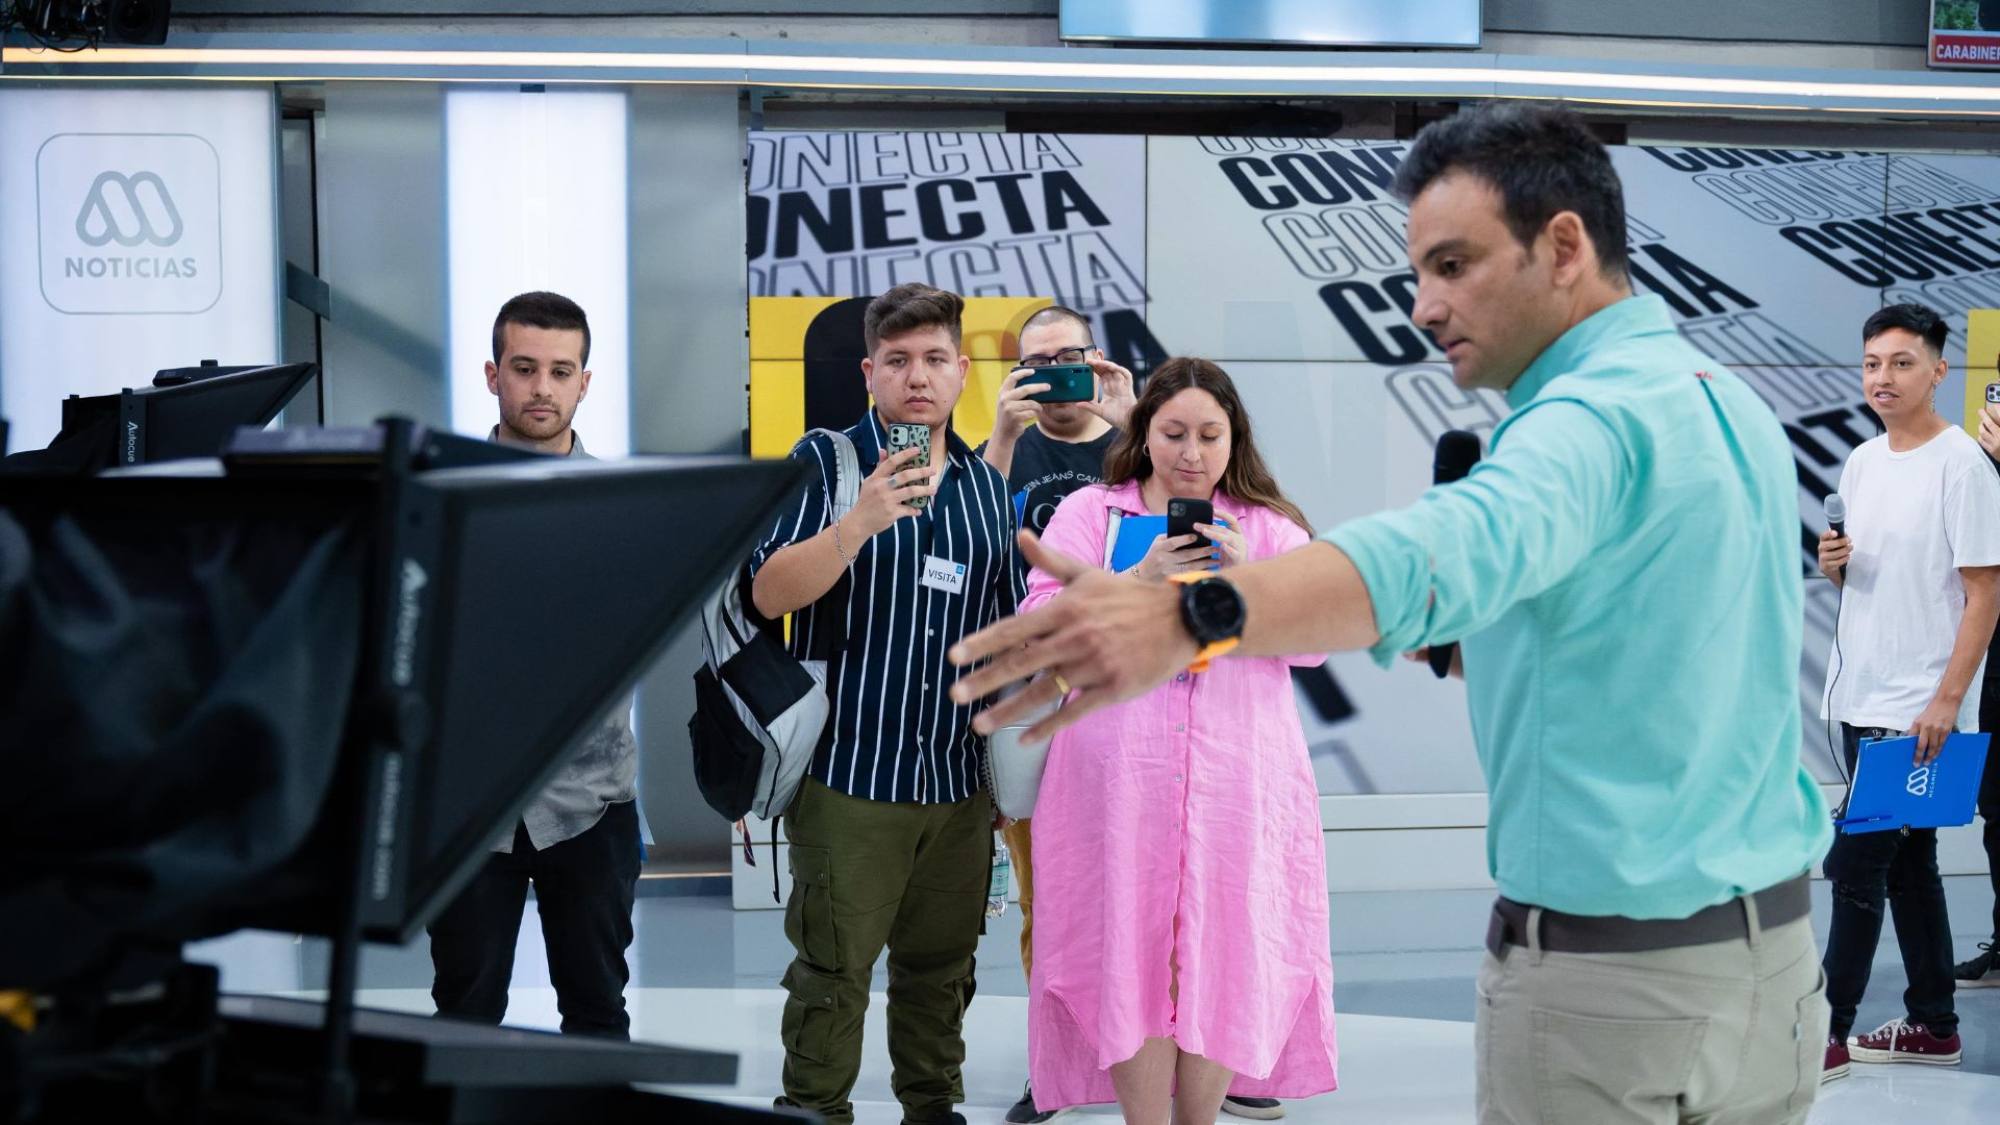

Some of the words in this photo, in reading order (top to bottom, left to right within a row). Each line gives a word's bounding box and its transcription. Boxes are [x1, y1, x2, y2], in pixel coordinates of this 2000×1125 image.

[65, 257, 197, 278] NOTICIAS
[127, 421, 138, 463] Autocue
[1042, 470, 1074, 484] JEANS
[928, 569, 956, 584] VISITA
